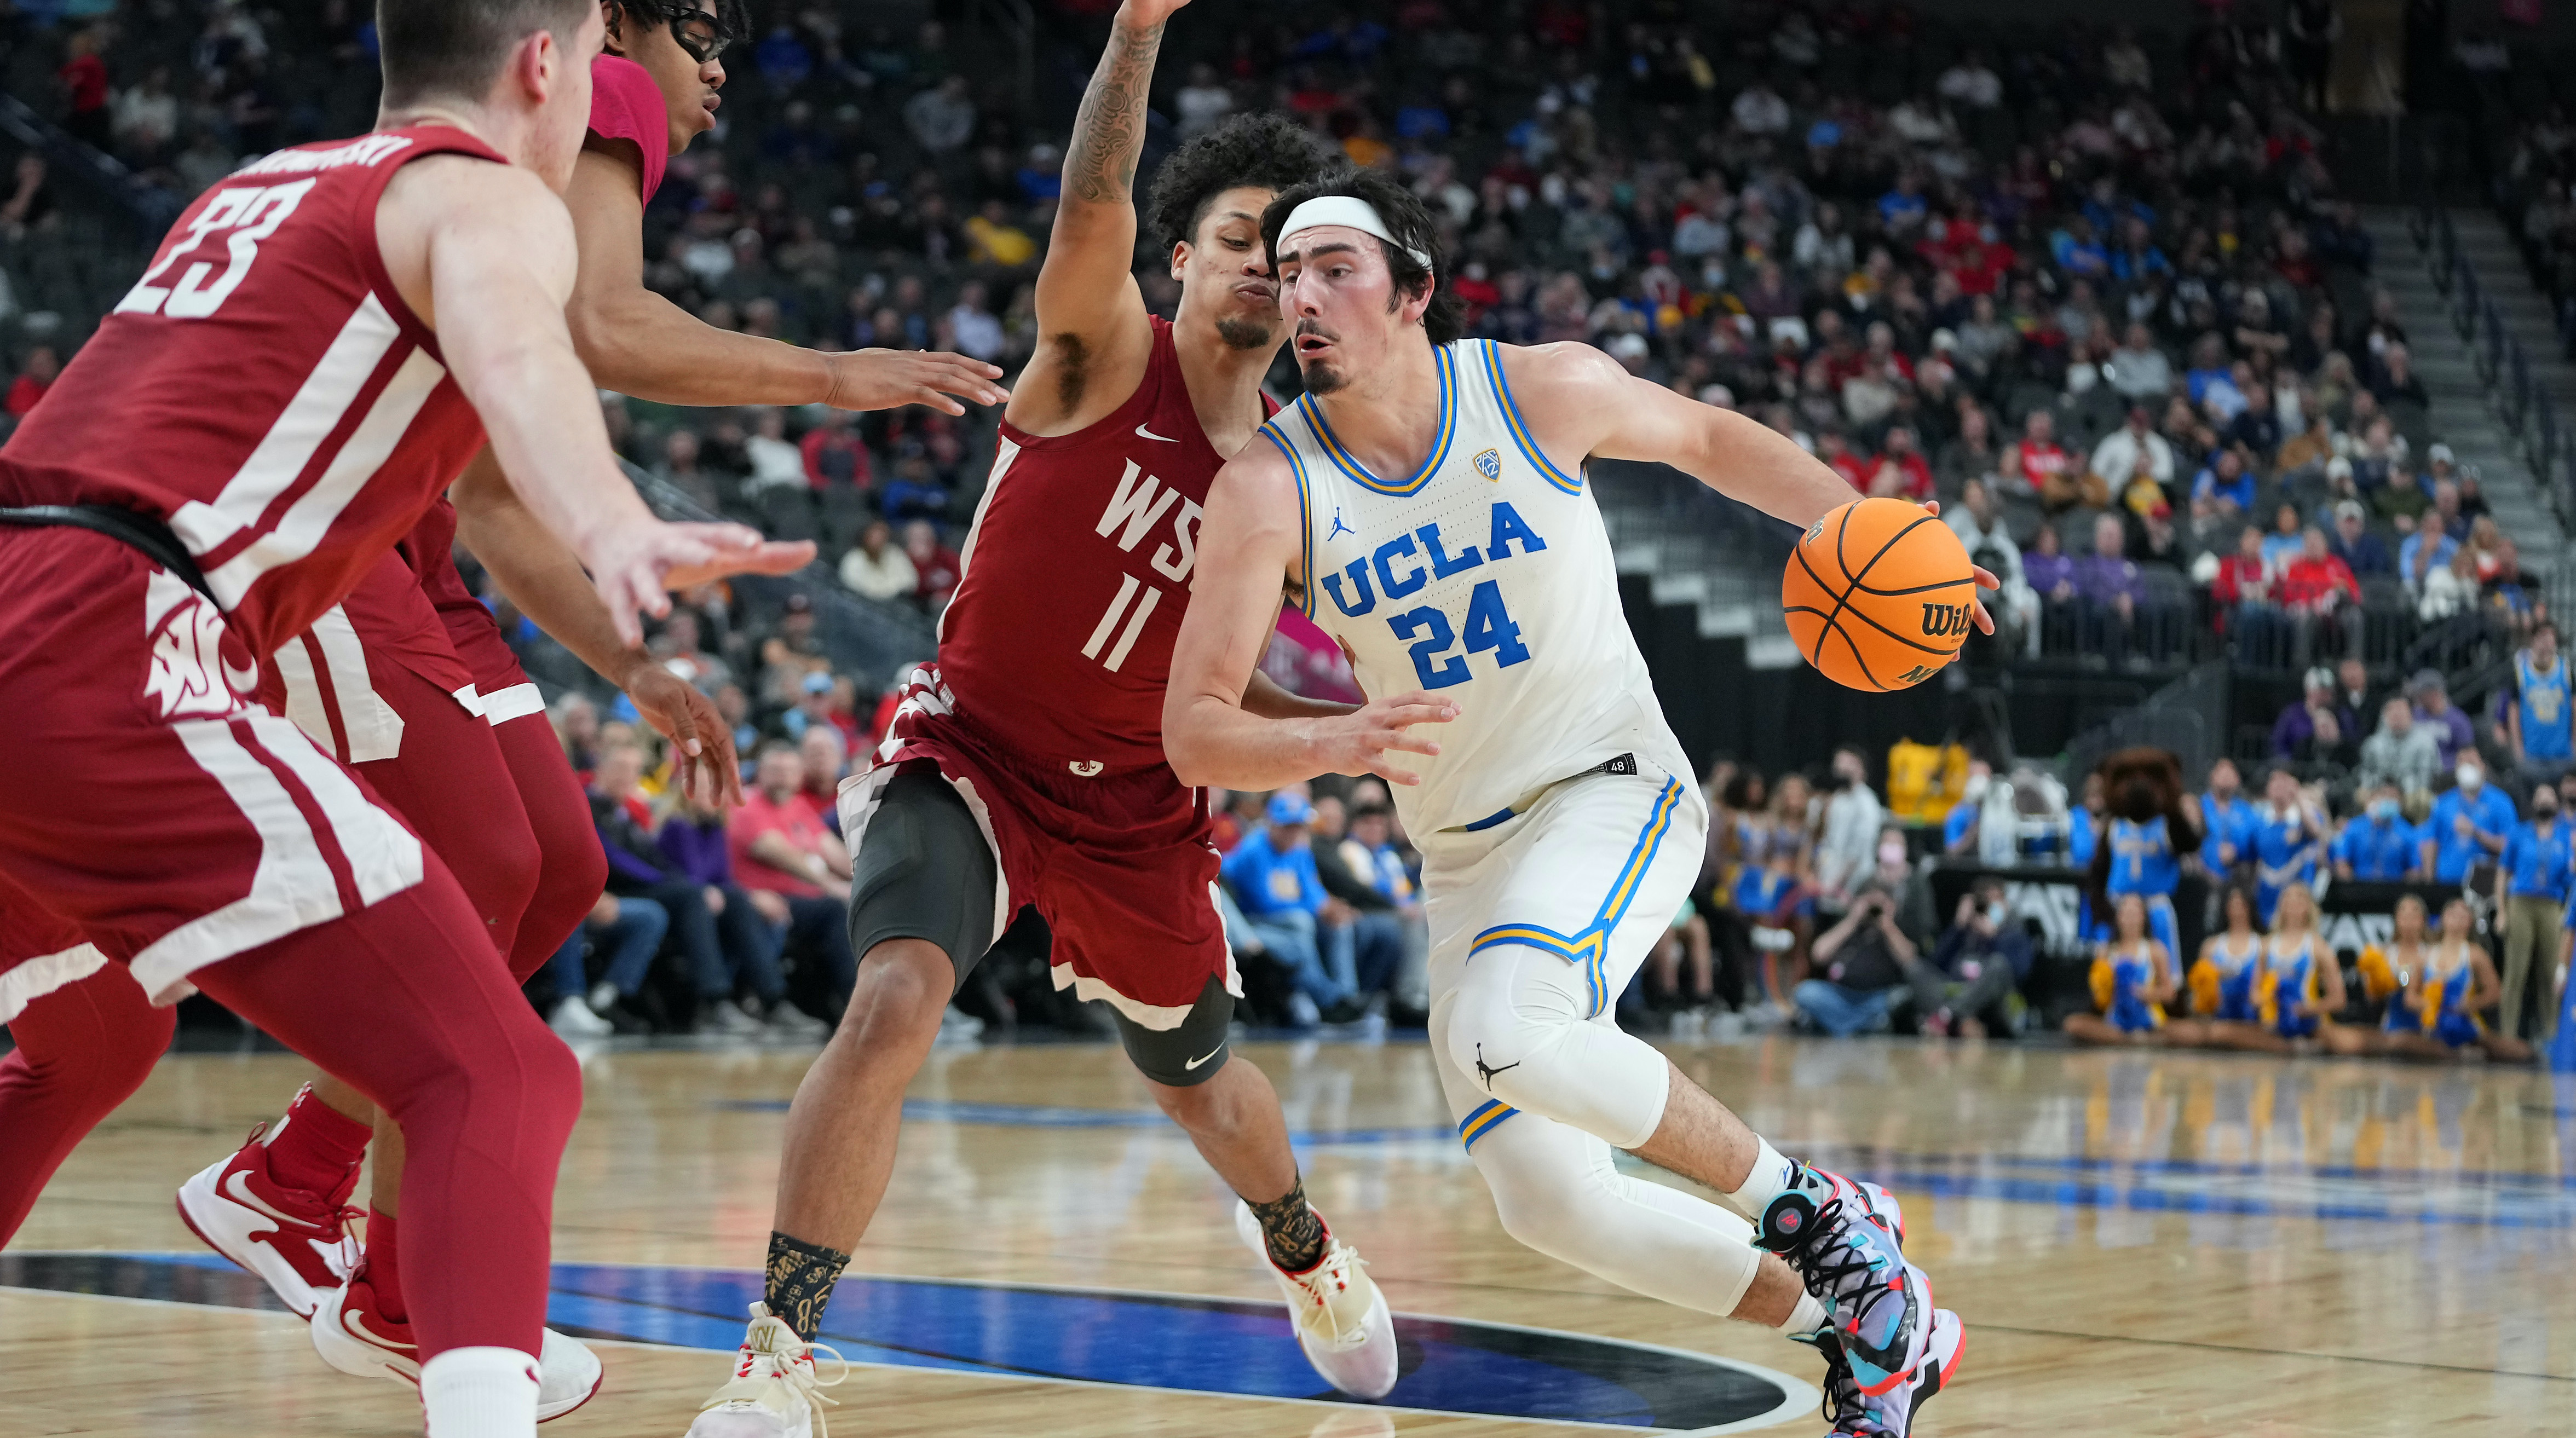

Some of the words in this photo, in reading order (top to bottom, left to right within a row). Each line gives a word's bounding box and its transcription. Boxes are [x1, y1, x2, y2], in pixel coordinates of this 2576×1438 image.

[113, 176, 317, 318] 23
[1474, 449, 1499, 474] PAC
[1484, 462, 1498, 477] 12
[1095, 457, 1203, 593] WS
[1321, 501, 1547, 617] UCLA
[1080, 572, 1162, 673] 11
[1386, 580, 1531, 690] 24
[1611, 761, 1624, 772] 48
